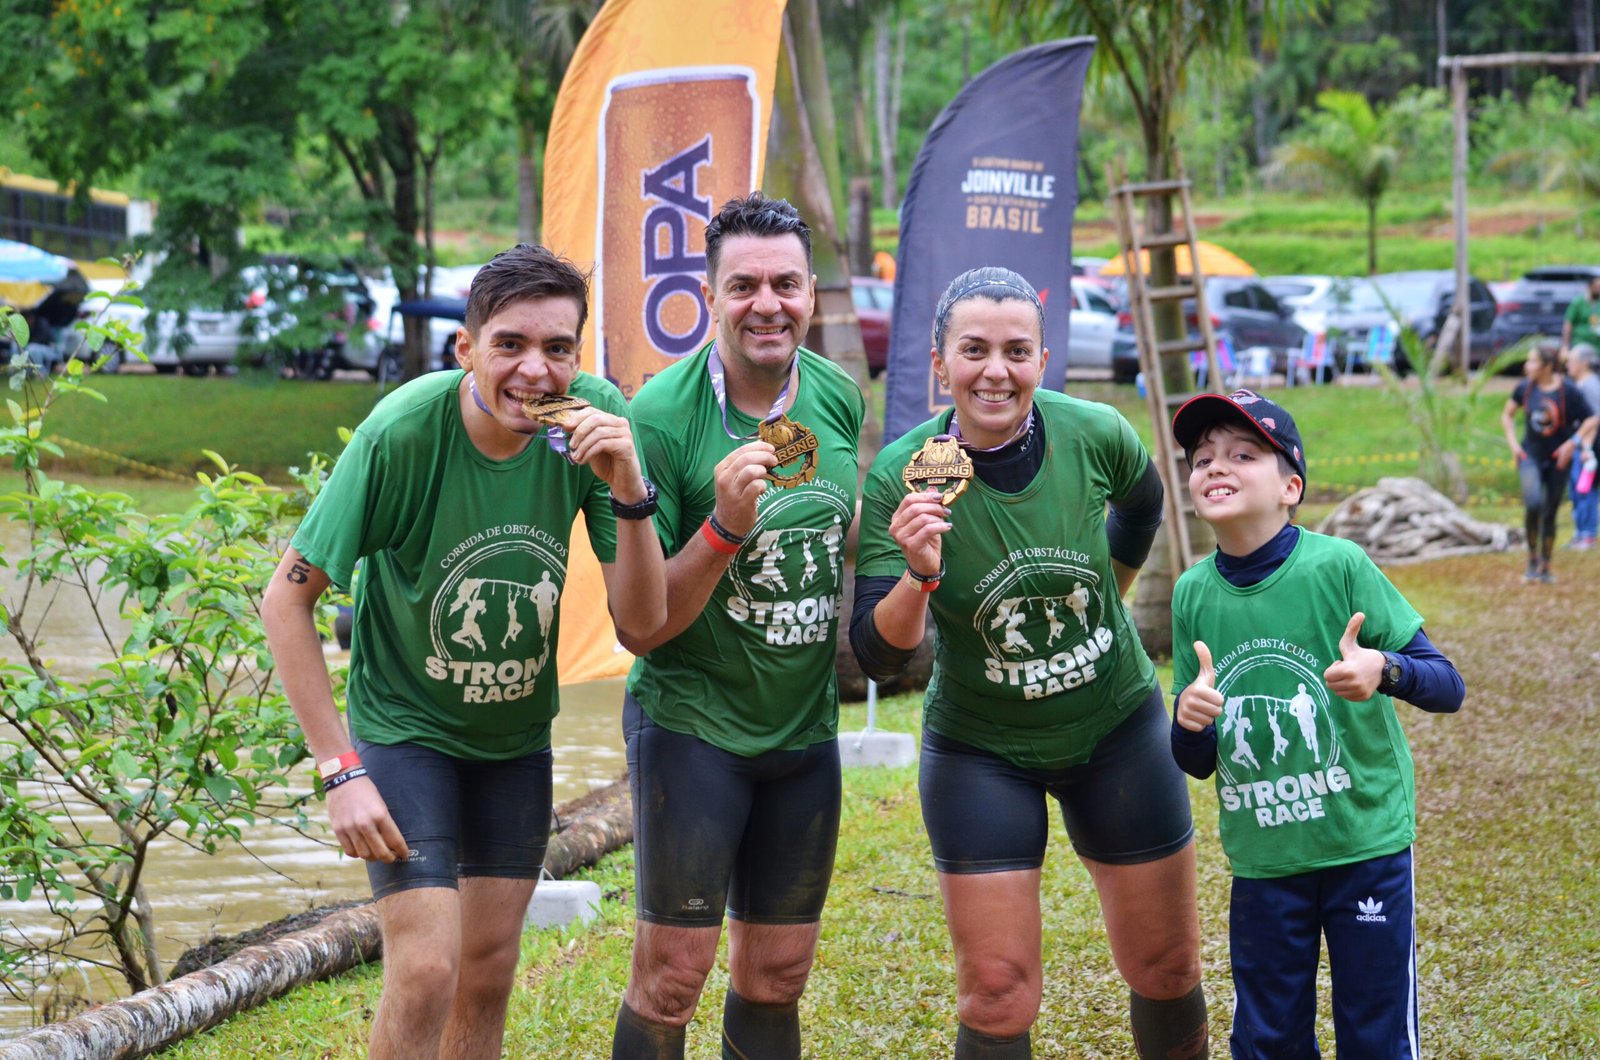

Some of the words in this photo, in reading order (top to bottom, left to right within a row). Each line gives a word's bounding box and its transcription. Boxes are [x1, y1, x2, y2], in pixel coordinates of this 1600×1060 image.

[961, 169, 1056, 199] JOINVILLE
[966, 205, 1044, 234] BRASIL
[641, 132, 713, 358] OPA
[777, 434, 818, 461] RONG
[904, 465, 970, 479] STRONG
[756, 486, 777, 506] RIDA
[799, 476, 849, 502] TÁCULOS
[440, 532, 485, 569] CORRIDA
[486, 526, 501, 539] DE
[503, 524, 568, 558] OBSTÁCULOS
[1009, 549, 1024, 562] DE
[1025, 546, 1090, 564] OBSTÁCULOS
[766, 621, 829, 646] RACE
[425, 653, 547, 685] STRON
[984, 626, 1113, 686] STRONG
[1214, 650, 1237, 677] RRIDA
[1237, 641, 1251, 655] DE
[1251, 638, 1320, 668] OBSTÁCULOS
[463, 678, 535, 704] RACE
[1023, 663, 1097, 701] RACE
[1220, 765, 1352, 812] STRONG
[1255, 797, 1325, 828] RACE
[1356, 913, 1387, 922] adidas
